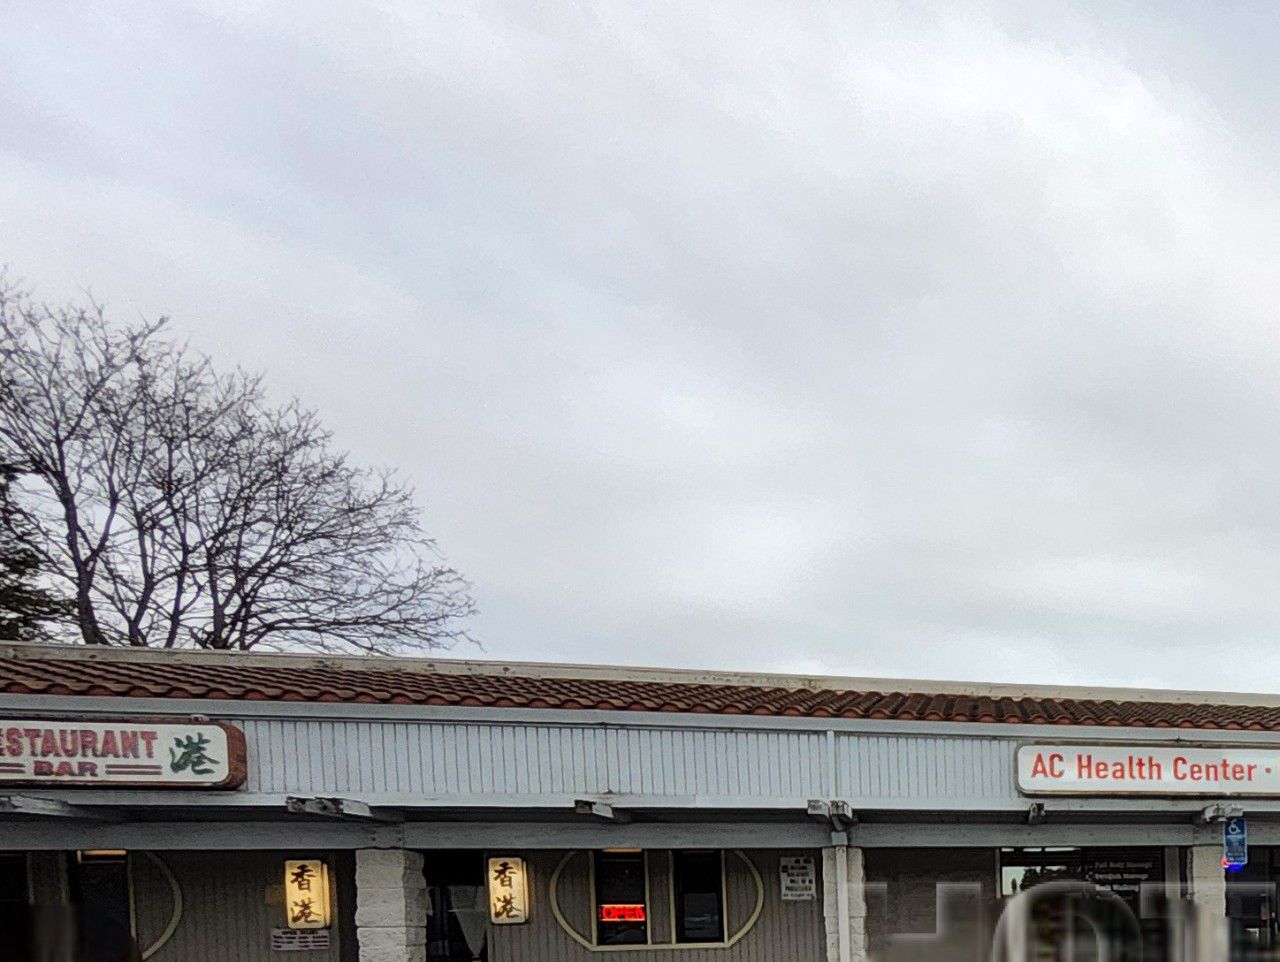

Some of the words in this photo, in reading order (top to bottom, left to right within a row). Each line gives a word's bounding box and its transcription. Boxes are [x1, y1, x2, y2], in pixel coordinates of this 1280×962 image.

[0, 727, 158, 759] STAURANT
[169, 732, 220, 775] 港
[33, 760, 98, 777] BAR
[1030, 753, 1064, 778] AC
[1077, 754, 1162, 781] Health
[1173, 756, 1257, 782] Center
[290, 864, 322, 923] 香港
[492, 861, 522, 919] 香港
[602, 905, 645, 920] OPEN
